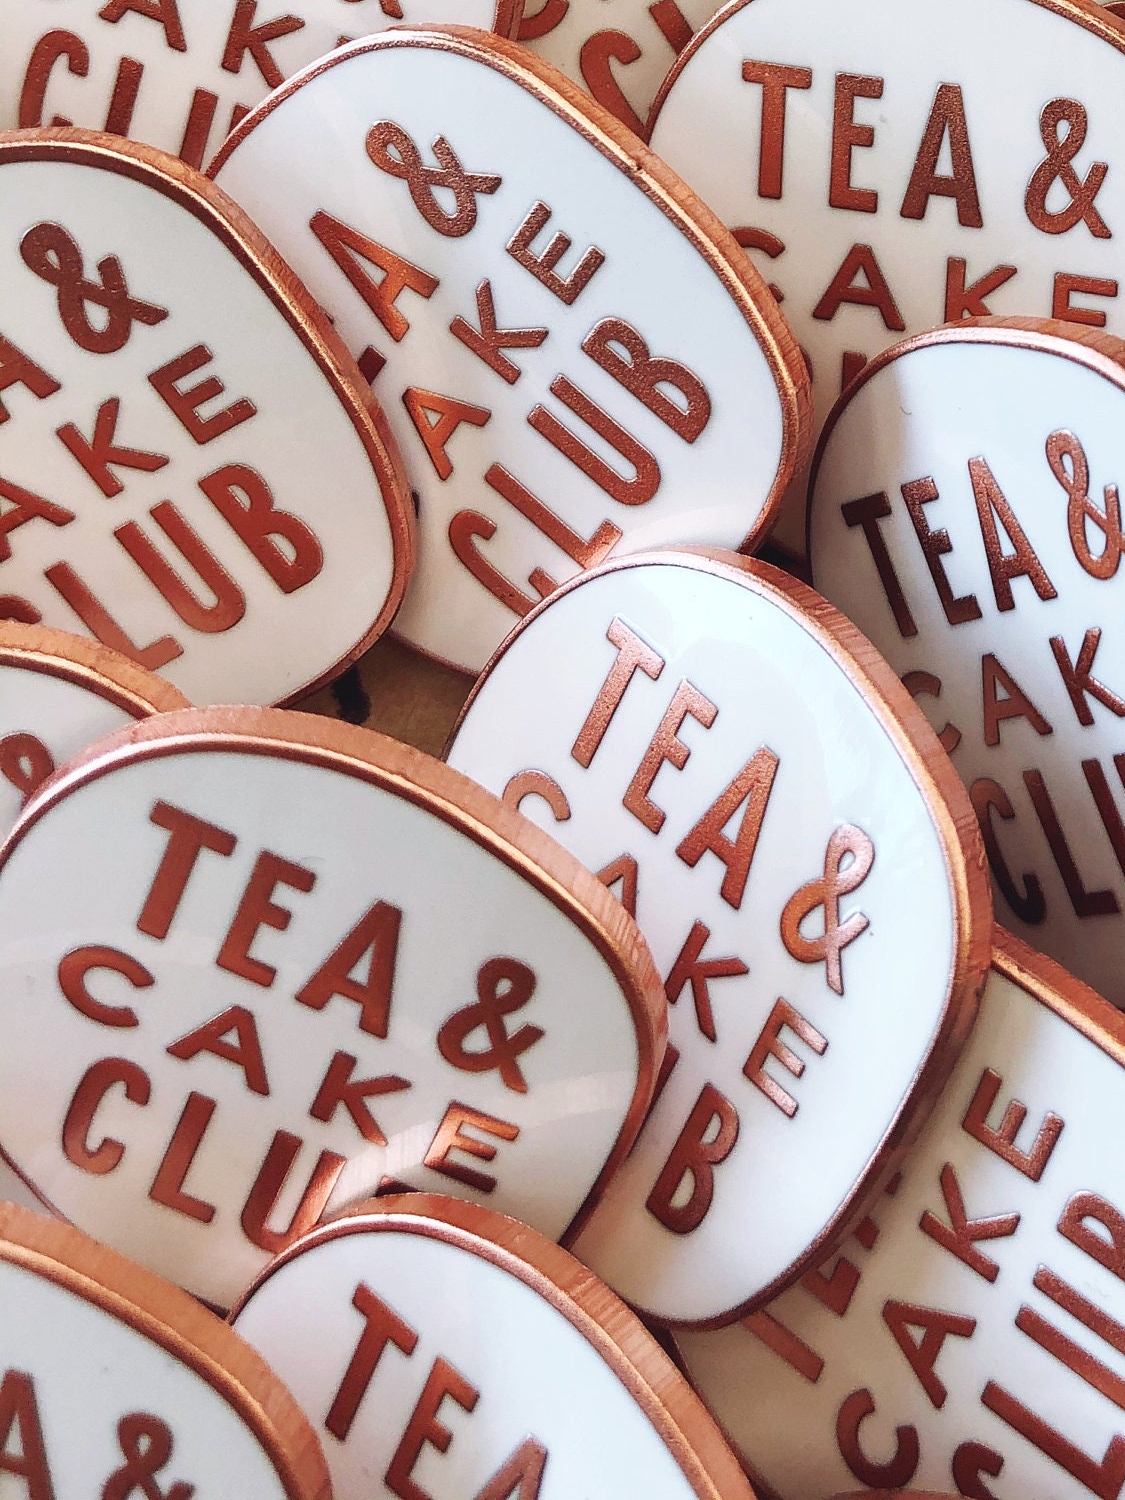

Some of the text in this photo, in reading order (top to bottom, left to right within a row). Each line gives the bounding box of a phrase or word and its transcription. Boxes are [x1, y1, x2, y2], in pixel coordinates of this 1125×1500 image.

[366, 120, 502, 237] &
[742, 60, 1112, 239] TEA &
[20, 222, 168, 353] &
[402, 201, 605, 480] AKE
[0, 463, 324, 672] LUB
[449, 316, 712, 618] CLUB
[841, 457, 1057, 637] TEA
[571, 614, 875, 995] TEA &
[136, 800, 545, 1093] TEA &
[58, 944, 519, 1193] CAKE
[62, 1057, 360, 1254] CLU
[836, 1068, 1065, 1489] CAKE
